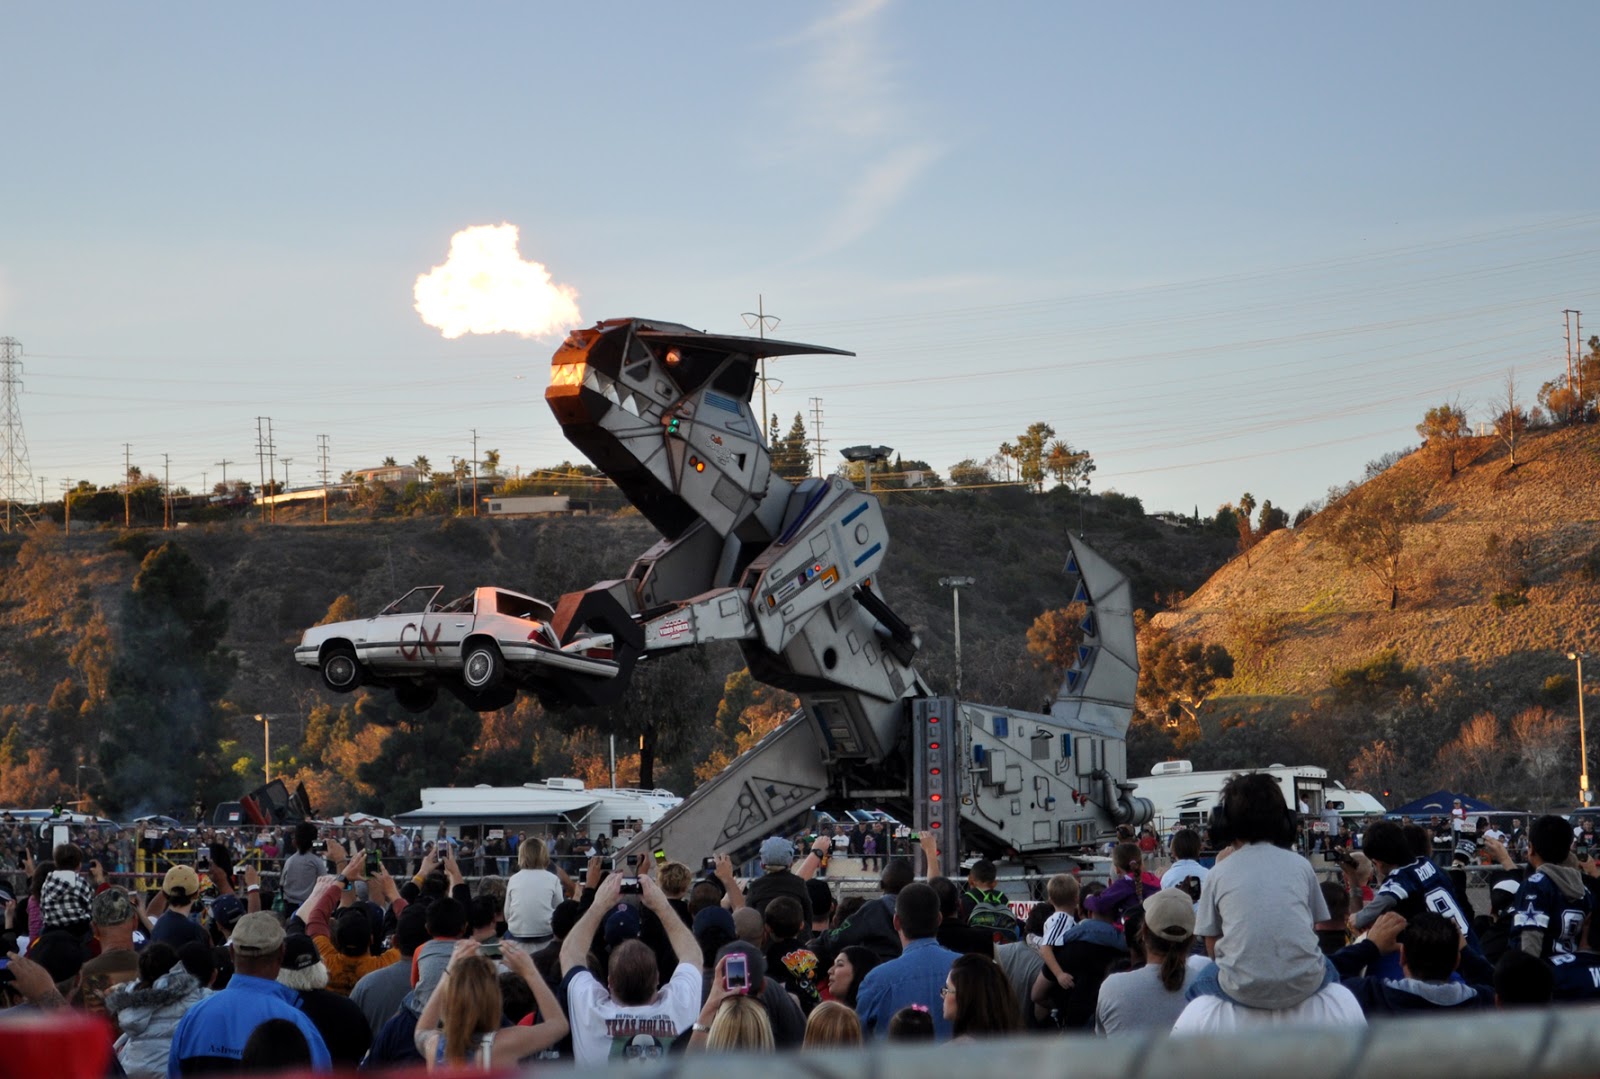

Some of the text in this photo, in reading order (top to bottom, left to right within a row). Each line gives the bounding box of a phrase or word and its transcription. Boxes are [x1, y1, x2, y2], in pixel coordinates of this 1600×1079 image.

[660, 627, 673, 635] VIDEO
[1424, 886, 1469, 938] 9
[605, 1019, 637, 1036] TEXAS
